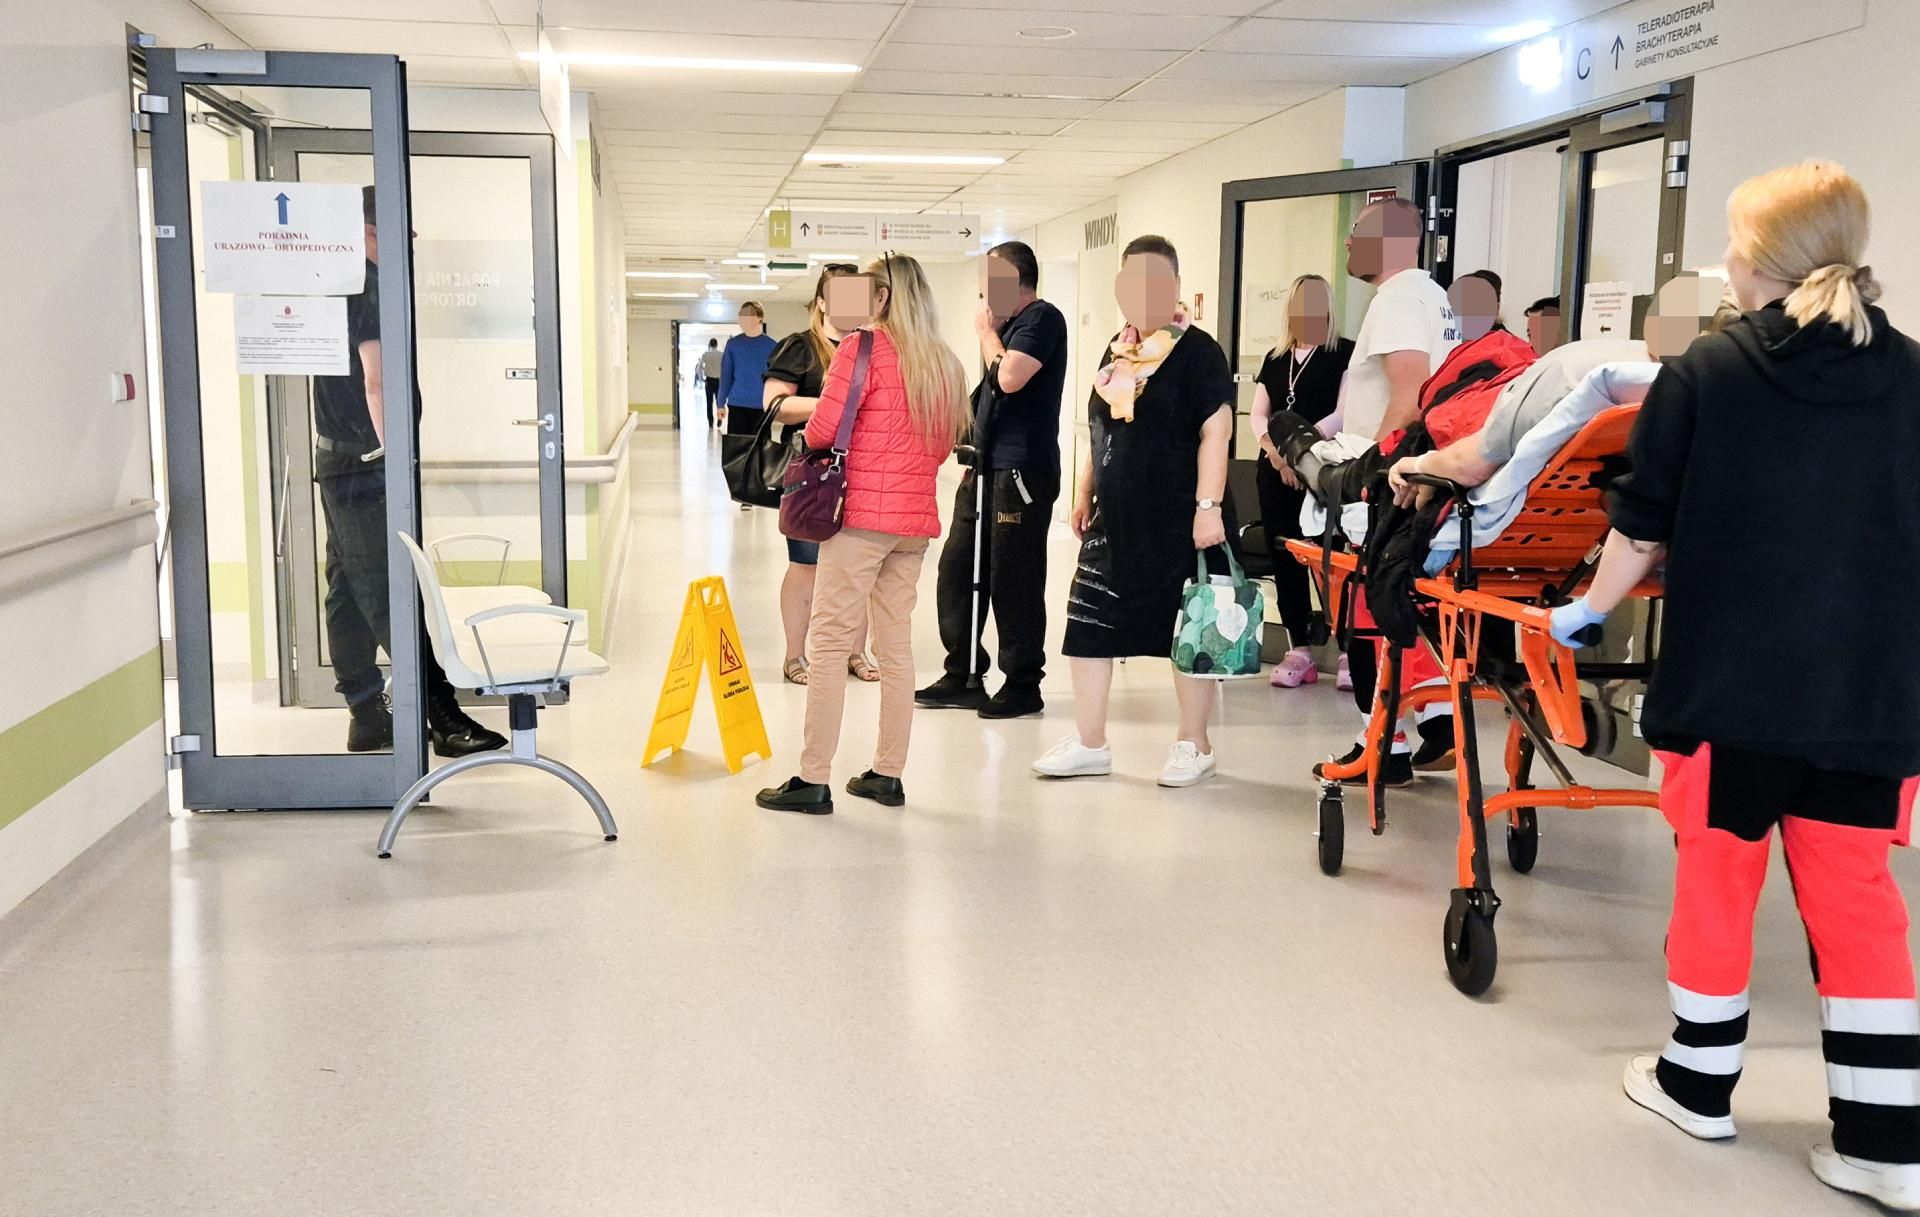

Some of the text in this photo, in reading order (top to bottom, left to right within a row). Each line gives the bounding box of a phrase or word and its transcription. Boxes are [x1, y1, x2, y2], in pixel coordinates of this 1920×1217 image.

[1637, 0, 1715, 35] TELERADIOTERAPIA
[1634, 35, 1719, 69] GABINETY KONSULTACYJNE
[1636, 22, 1702, 53] BRACHYTERAPIA
[1577, 47, 1591, 80] C
[258, 231, 309, 240] PORADNIA
[773, 221, 787, 237] H
[1085, 212, 1117, 251] WINDY
[214, 242, 265, 251] URAZOWO
[274, 242, 354, 253] ORTOPEDYCZNA
